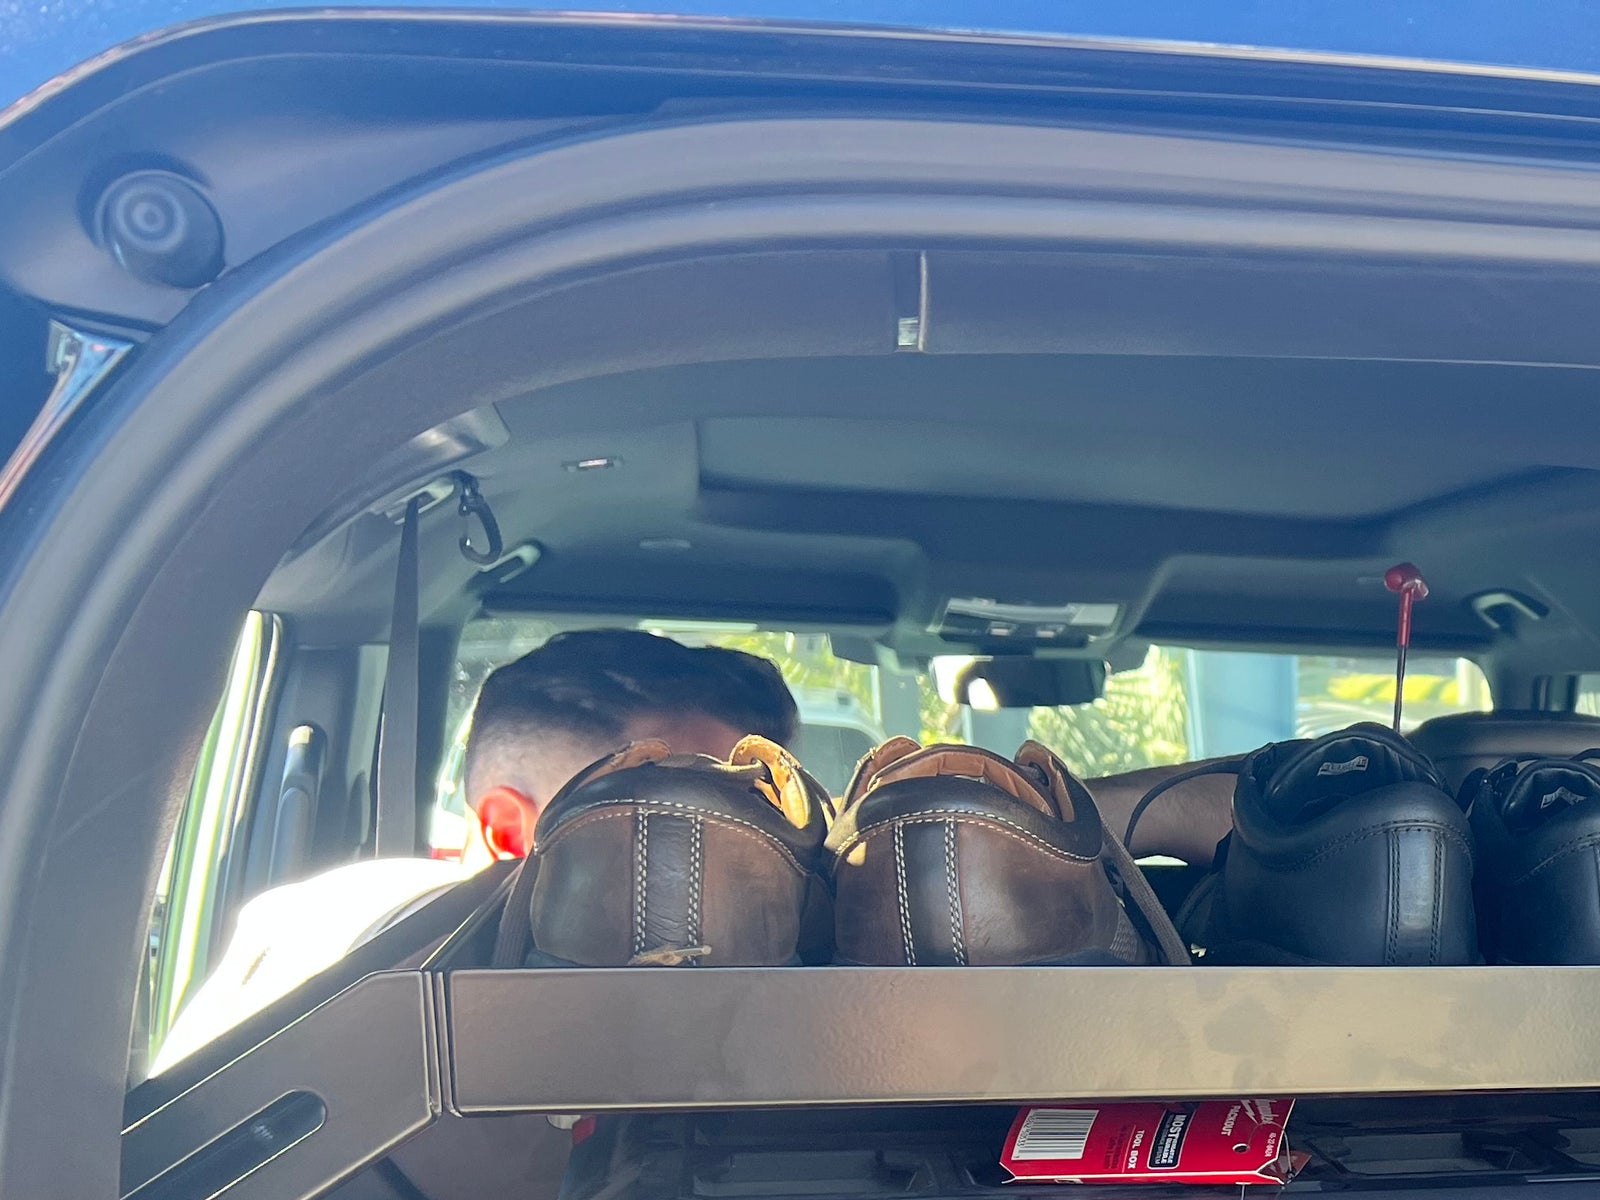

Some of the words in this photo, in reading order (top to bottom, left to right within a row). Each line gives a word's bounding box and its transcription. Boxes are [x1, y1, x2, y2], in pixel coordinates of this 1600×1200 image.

[1167, 1113, 1187, 1139] MOST
[1131, 1129, 1145, 1149] TOOL
[1127, 1149, 1139, 1169] BOX
